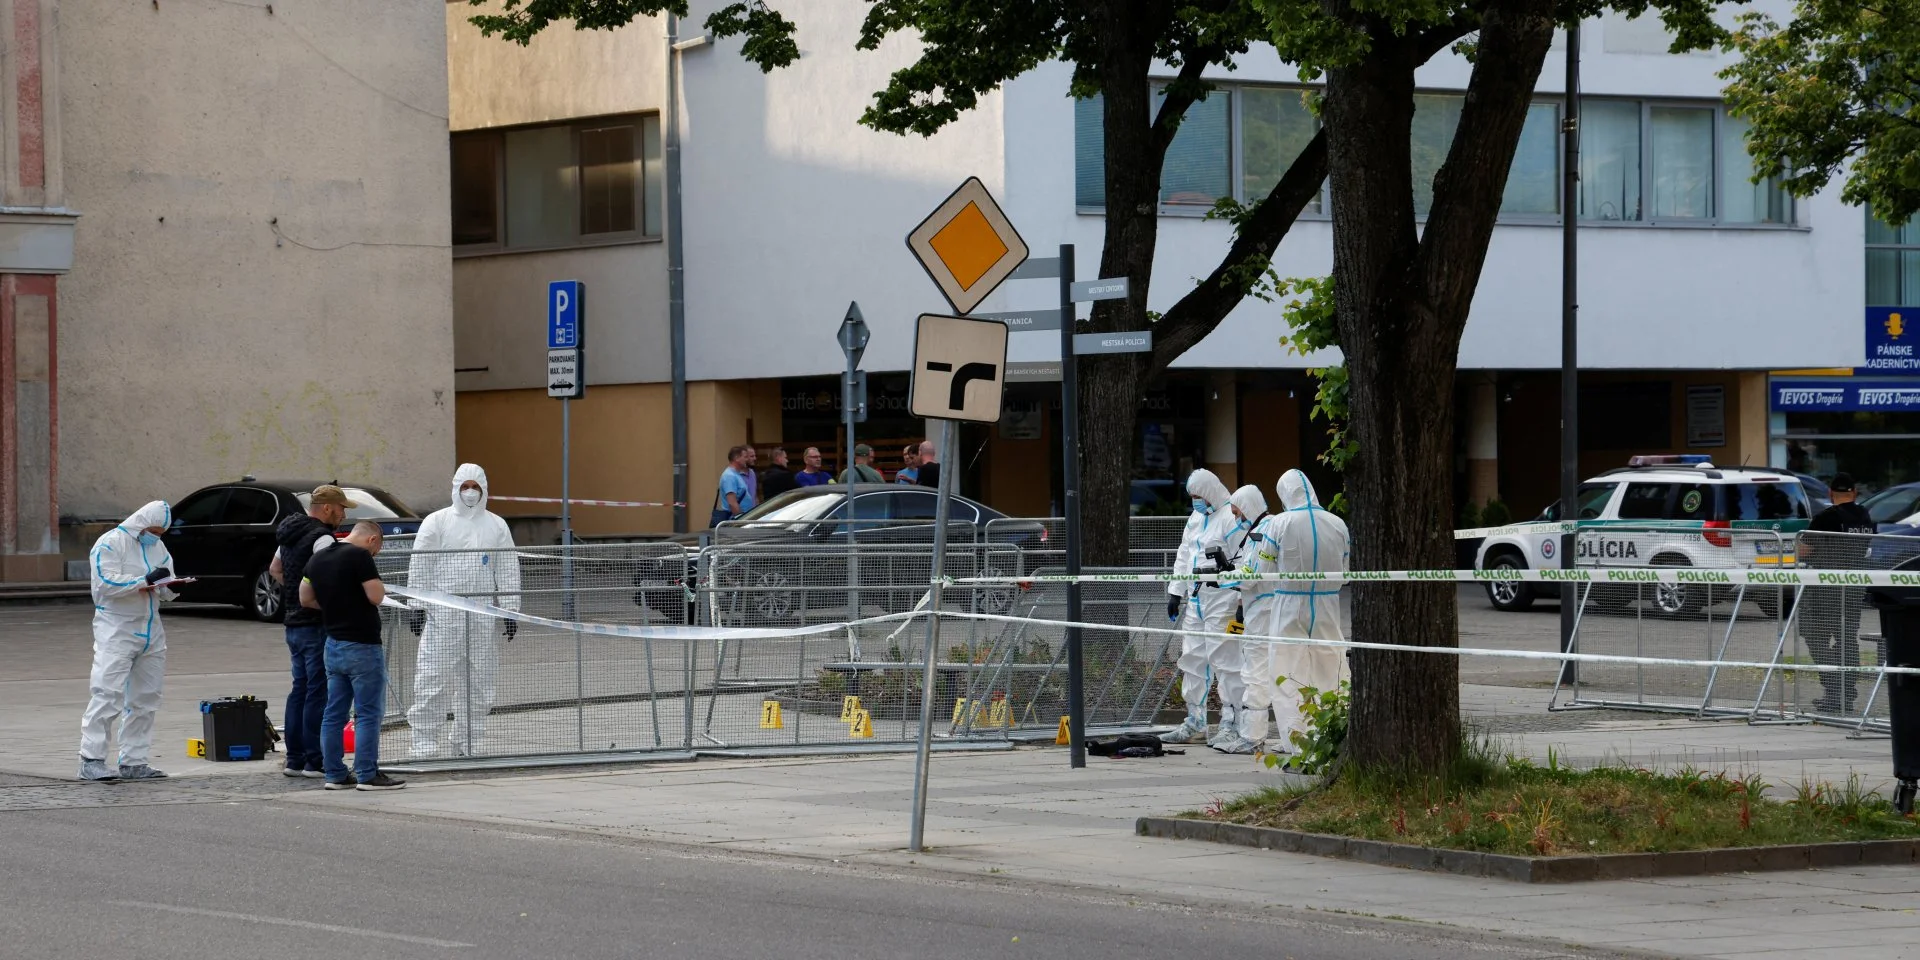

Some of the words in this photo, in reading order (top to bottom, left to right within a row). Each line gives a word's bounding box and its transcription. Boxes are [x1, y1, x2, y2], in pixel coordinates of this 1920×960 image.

[556, 290, 569, 326] P
[1101, 337, 1125, 347] MESTSKÁ
[1125, 337, 1146, 347] POLÍCIA
[1877, 344, 1913, 356] PÁNSKE
[549, 355, 575, 364] PARKOVANIE
[1865, 357, 1920, 369] KADERNÍCTV
[781, 392, 815, 410] caffe
[1779, 388, 1815, 405] TEVOS
[1858, 388, 1893, 405] TEVOS
[1577, 536, 1638, 558] OLÍCIA
[766, 704, 773, 723] 1
[854, 713, 863, 731] 2
